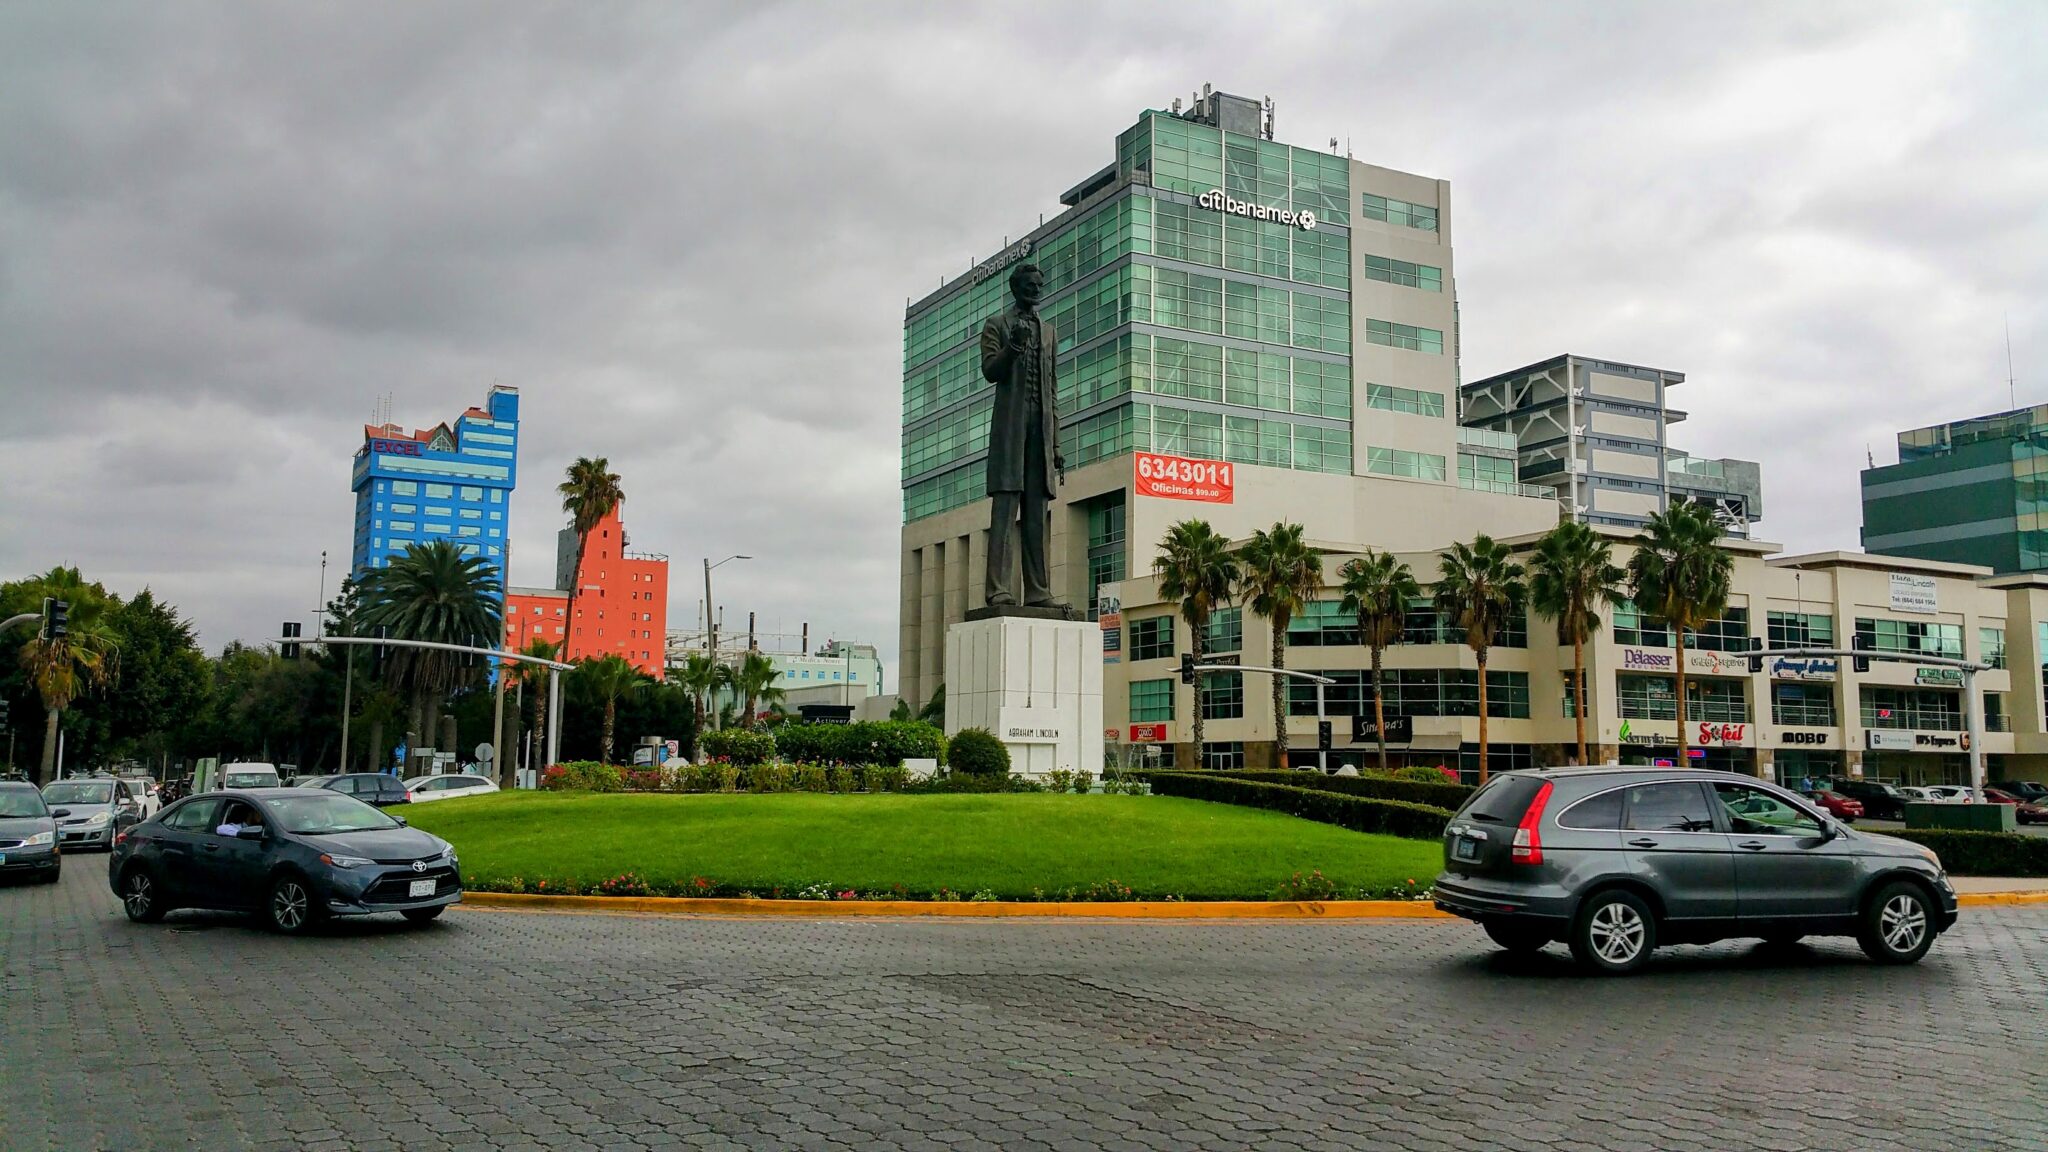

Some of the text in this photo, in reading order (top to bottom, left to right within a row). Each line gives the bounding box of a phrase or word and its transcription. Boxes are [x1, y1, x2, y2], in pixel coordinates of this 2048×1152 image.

[1199, 189, 1299, 226] citibanamex
[972, 245, 1021, 285] citibanamex
[375, 440, 422, 456] EXCEL
[1139, 457, 1230, 486] 6343011
[1151, 482, 1219, 497] Oficinas $99.00
[1624, 649, 1672, 667] Délasser
[1009, 728, 1059, 738] ABRAHAM LINCOLN
[1360, 720, 1403, 736] SINARA'S
[1782, 732, 1827, 744] MOBO
